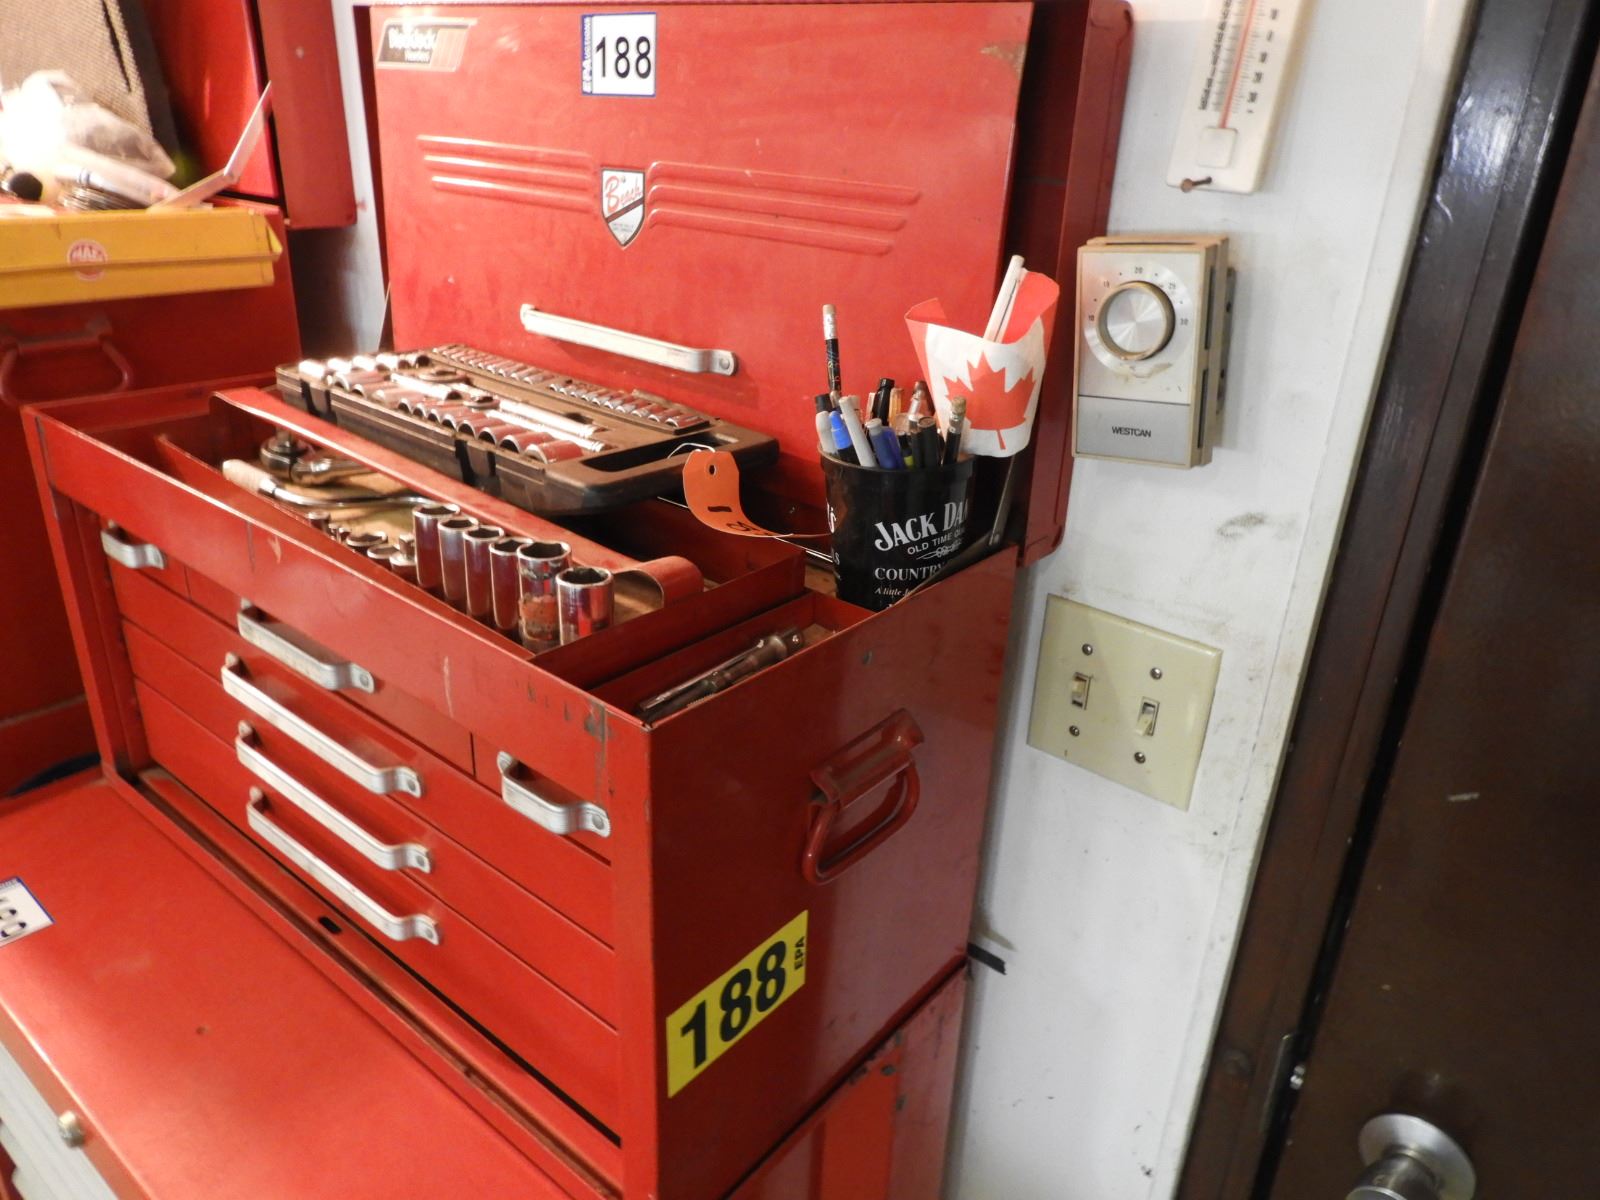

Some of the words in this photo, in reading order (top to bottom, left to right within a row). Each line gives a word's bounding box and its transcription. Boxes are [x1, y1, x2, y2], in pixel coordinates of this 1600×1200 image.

[596, 36, 651, 79] 188
[1112, 426, 1151, 438] WESTCAN
[874, 512, 938, 551] JACK
[907, 542, 929, 555] OLD
[932, 532, 952, 546] TIME
[794, 935, 805, 971] EPA
[680, 940, 787, 1069] 188
